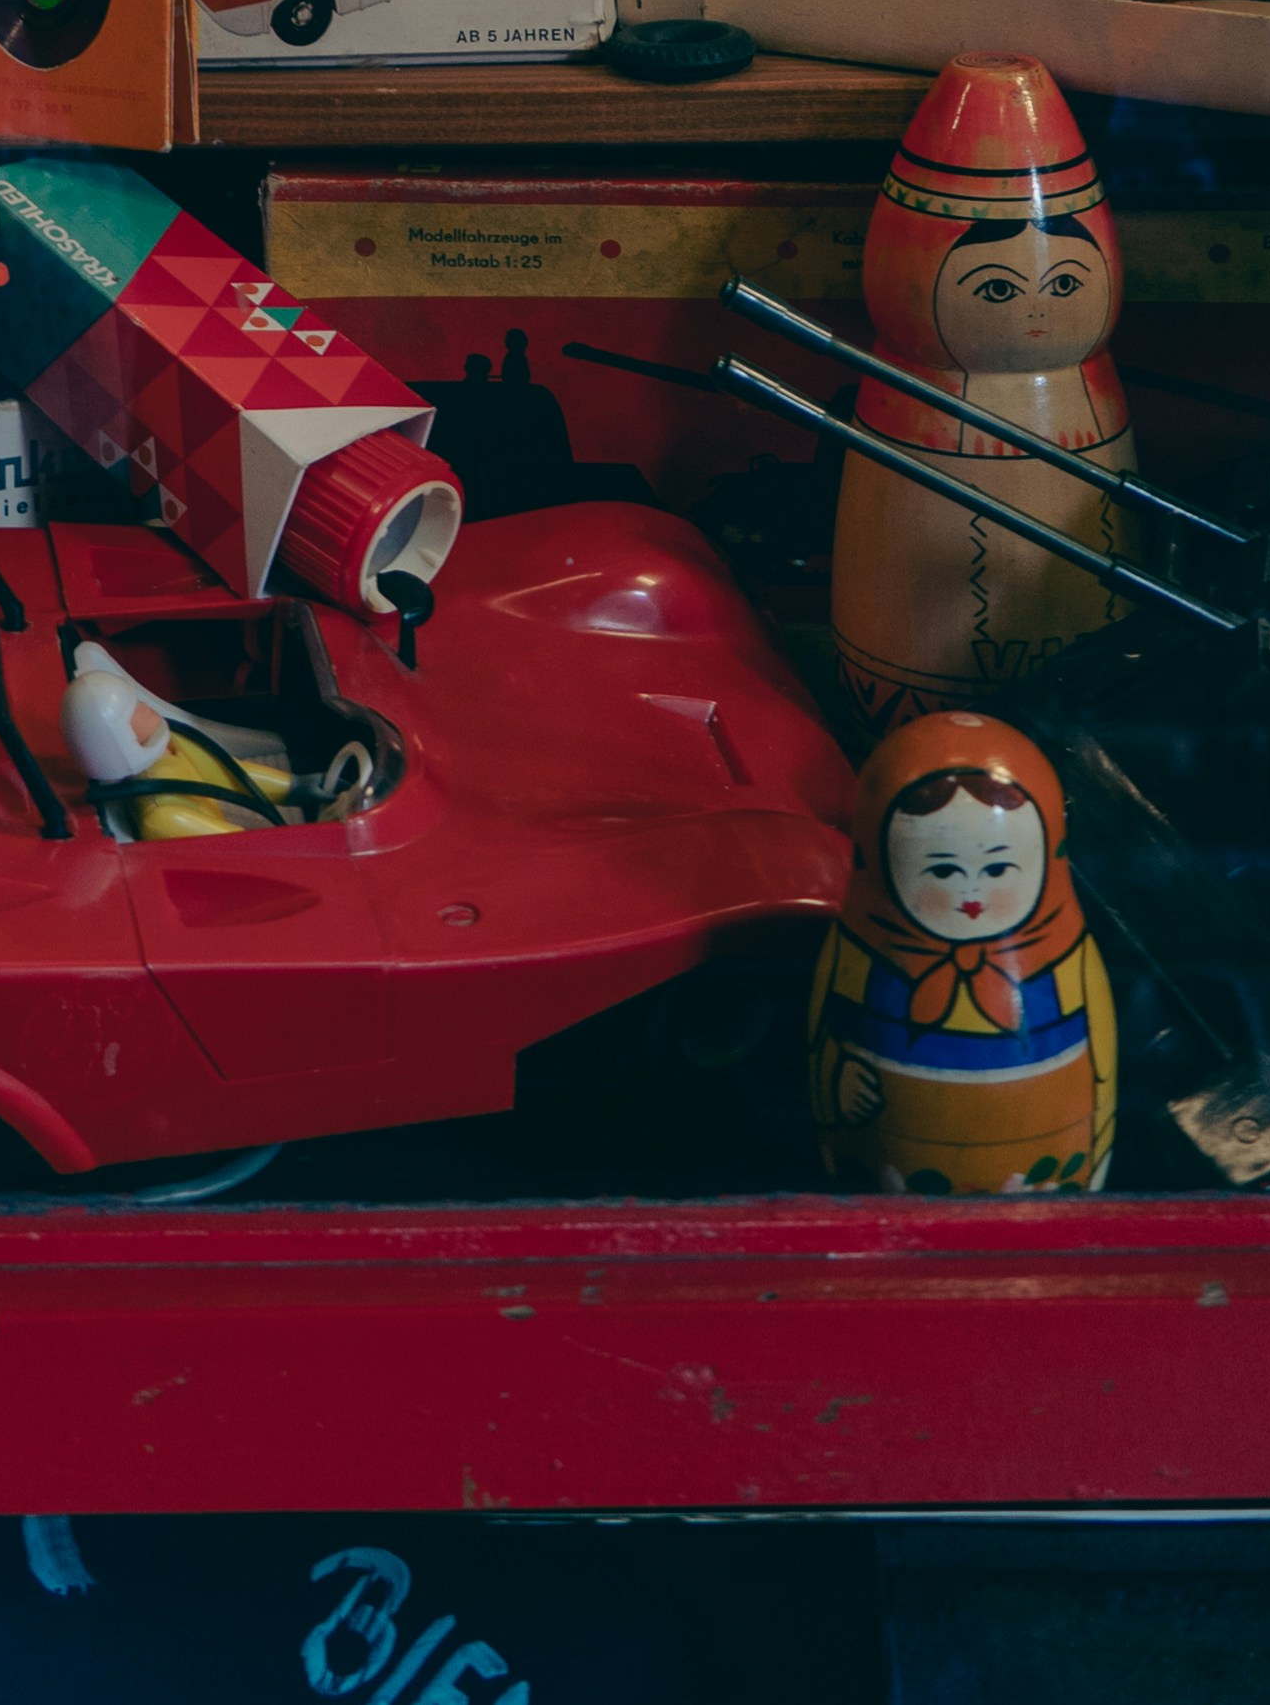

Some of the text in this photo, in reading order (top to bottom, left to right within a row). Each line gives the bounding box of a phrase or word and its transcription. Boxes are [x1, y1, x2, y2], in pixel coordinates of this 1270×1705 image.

[456, 26, 577, 44] AB 5 JAHREN
[407, 226, 563, 247] Modellfahrzeuge im
[832, 231, 865, 246] Kab
[430, 252, 501, 269] Maßstab
